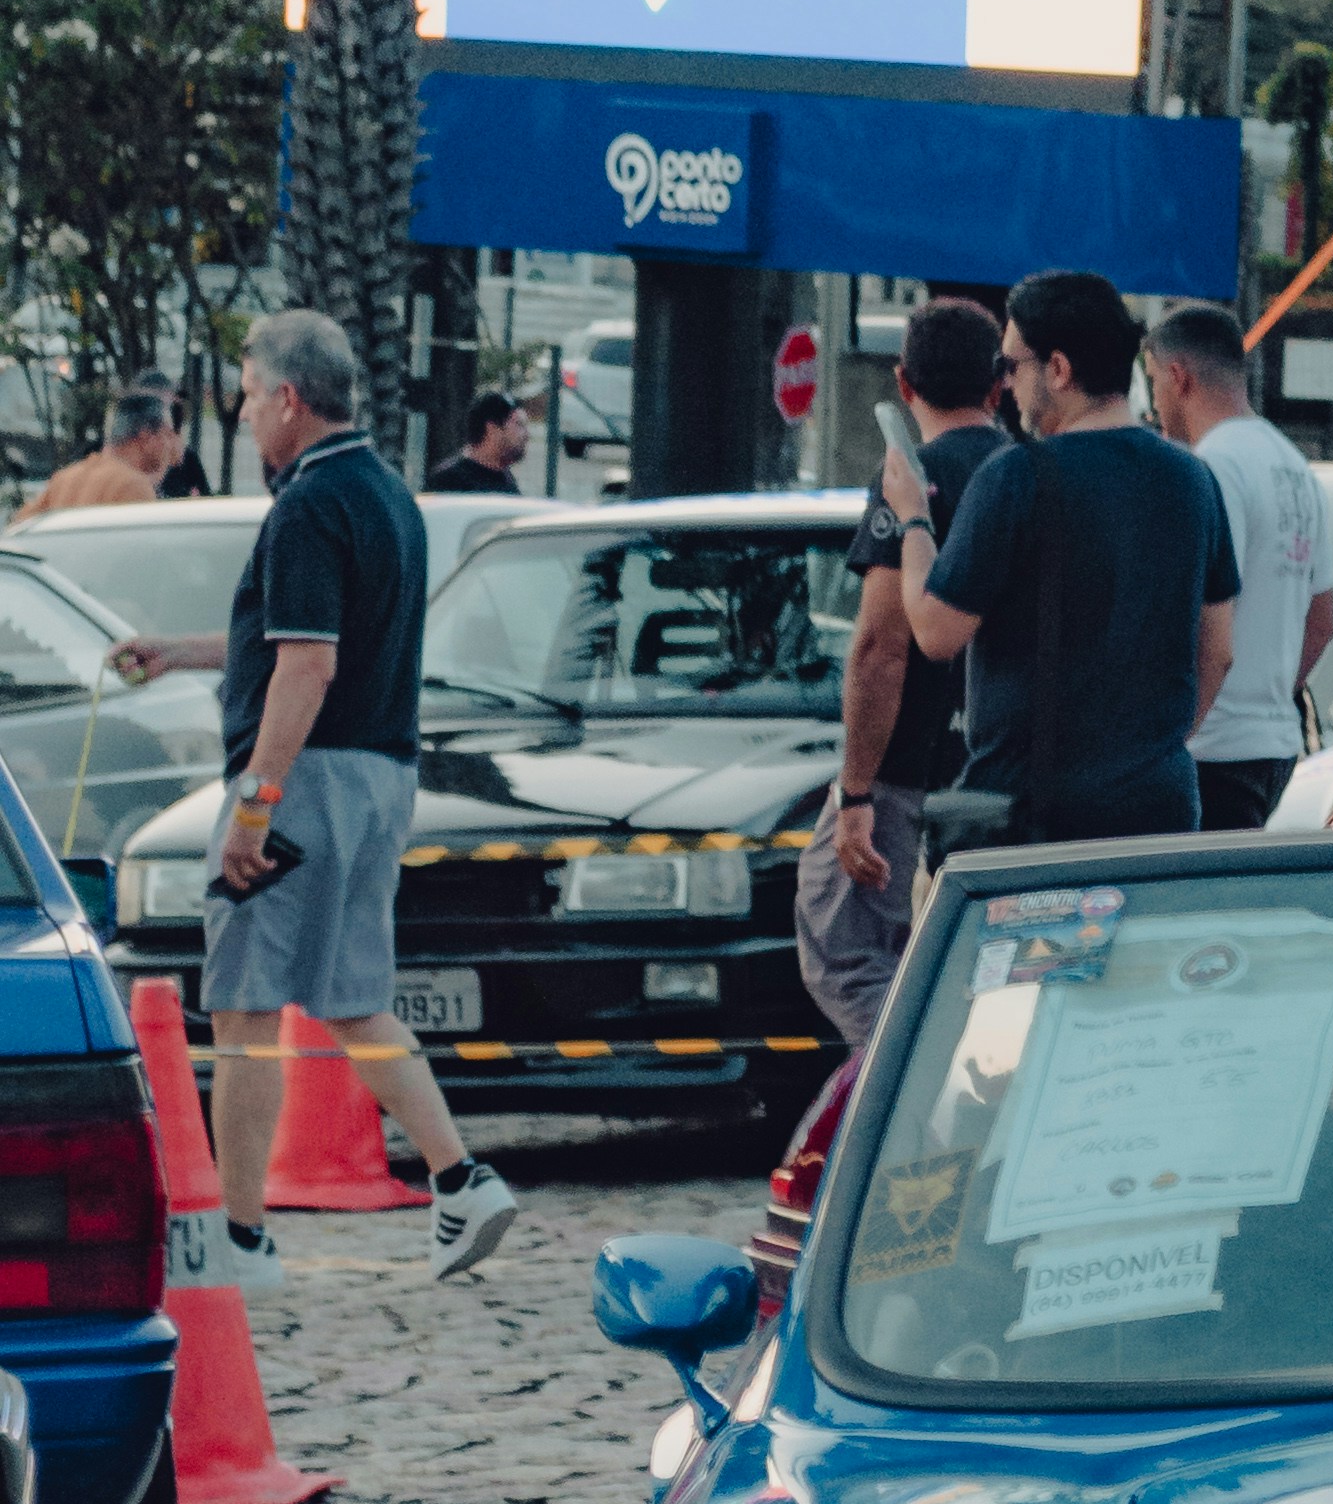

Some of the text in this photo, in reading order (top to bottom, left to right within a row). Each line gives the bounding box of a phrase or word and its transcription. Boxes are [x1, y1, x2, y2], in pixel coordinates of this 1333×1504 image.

[658, 146, 743, 185] ponto
[658, 178, 732, 214] certo
[1034, 1240, 1210, 1292] DISPONÍVEL
